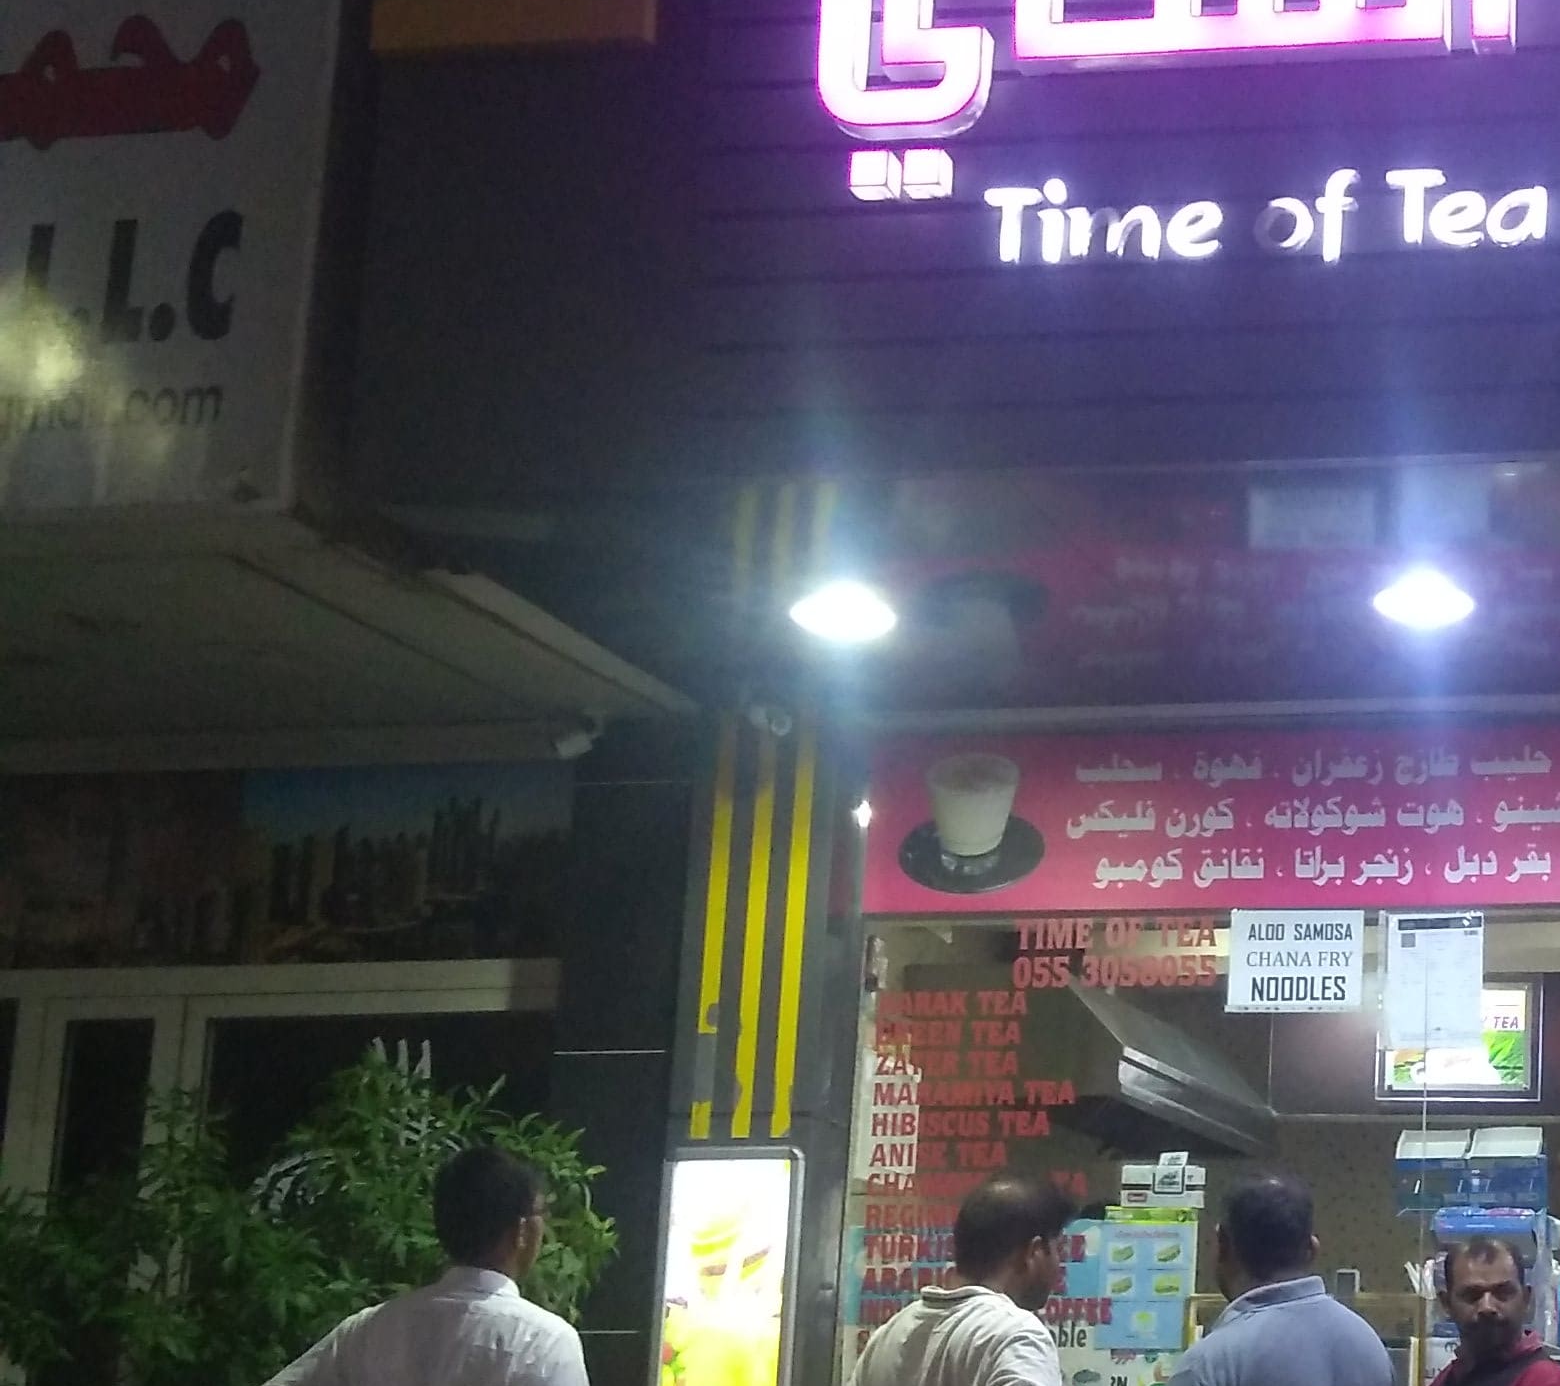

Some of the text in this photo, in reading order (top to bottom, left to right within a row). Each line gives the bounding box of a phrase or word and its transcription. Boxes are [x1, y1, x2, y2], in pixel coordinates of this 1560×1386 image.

[982, 177, 1224, 264] Time
[1254, 167, 1361, 264] of
[1384, 167, 1549, 248] Tea
[1015, 916, 1217, 950] TIME OF TEA
[1248, 922, 1354, 942] ALOO SAMOSA
[1012, 955, 1071, 989] 055
[1246, 950, 1354, 968] CHANA FRY
[1250, 975, 1347, 1003] NOODLES
[977, 990, 1028, 1016] TEA
[970, 1020, 1022, 1046] TEA
[1493, 1015, 1520, 1030] TEA
[967, 1050, 1018, 1076] TEA
[1024, 1080, 1076, 1105] TEA
[871, 1111, 1051, 1137] HIBISCUS TEA
[869, 1141, 1009, 1167] ANISE TEA
